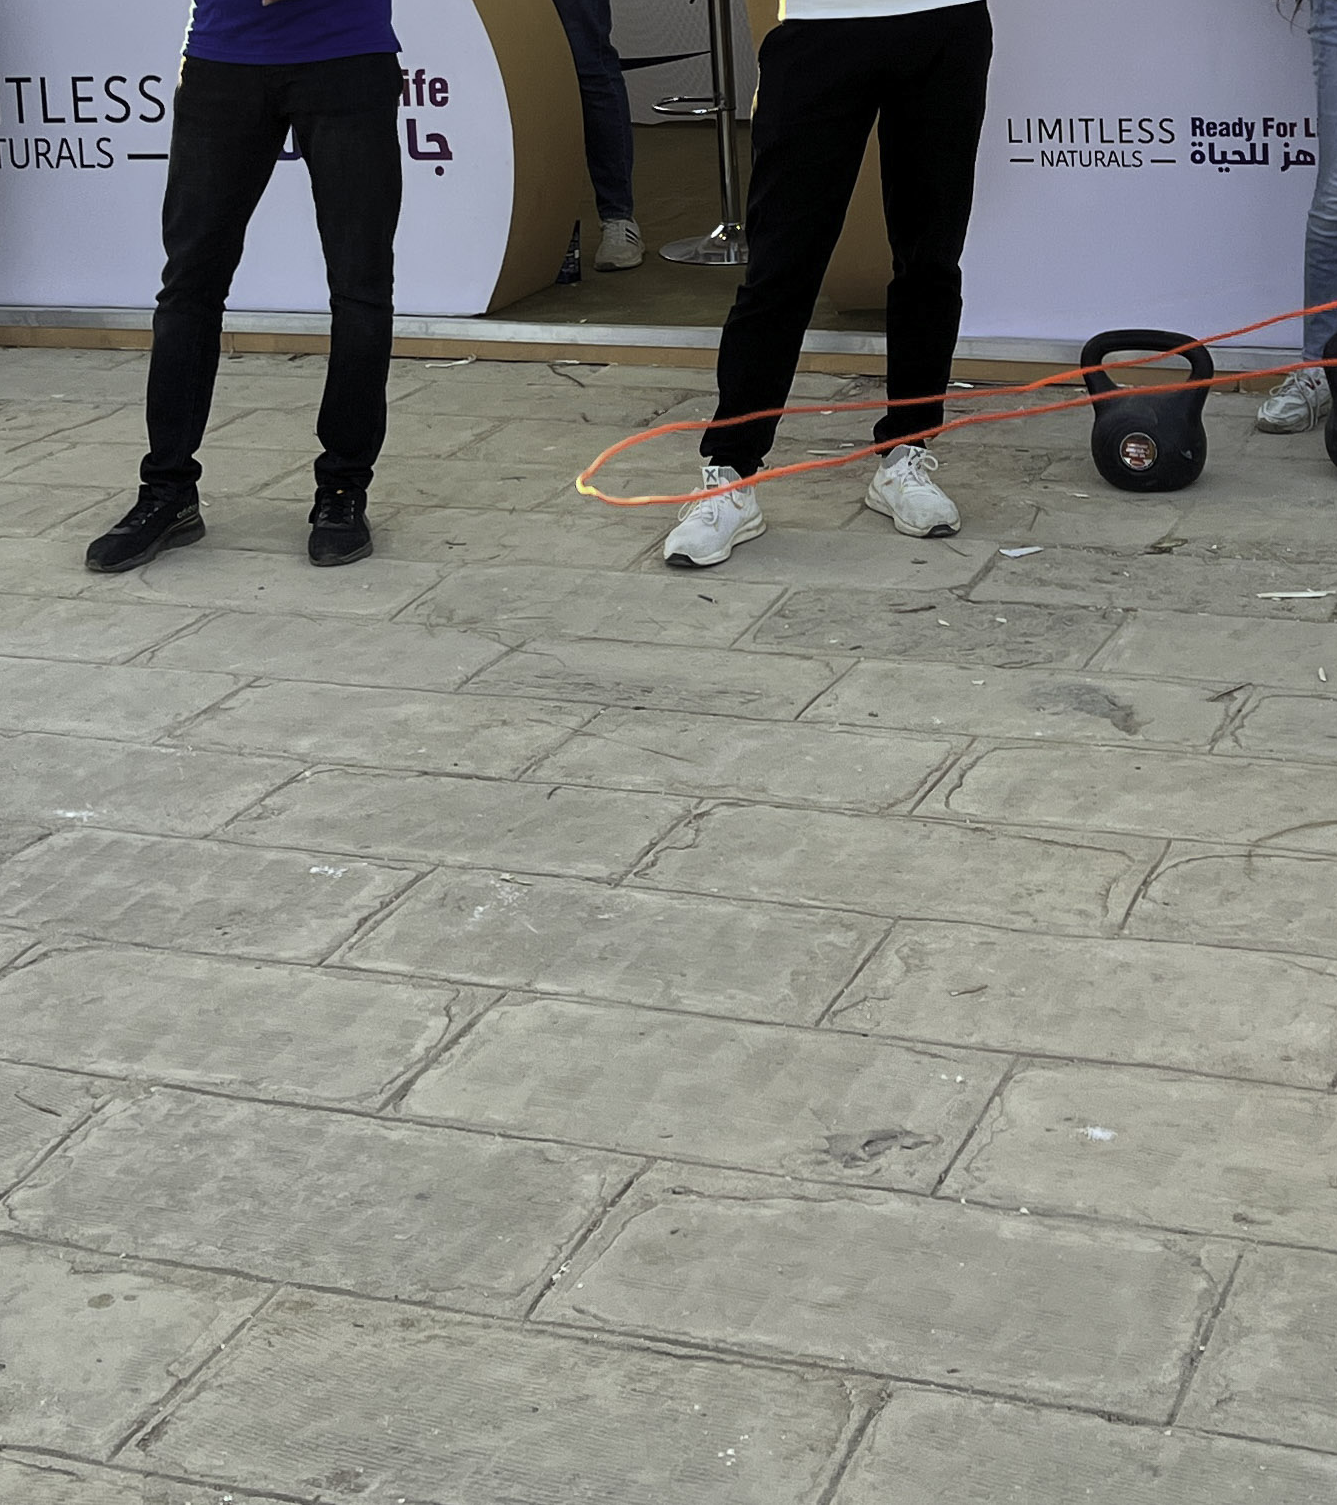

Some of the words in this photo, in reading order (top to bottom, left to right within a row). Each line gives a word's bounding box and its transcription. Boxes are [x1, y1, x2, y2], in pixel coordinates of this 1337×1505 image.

[402, 69, 450, 108] ife
[1007, 117, 1175, 145] LIMITLESS
[1190, 117, 1256, 142] Ready
[1263, 117, 1298, 138] For
[407, 118, 454, 177] جا
[1041, 150, 1143, 168] NATURALS
[1190, 142, 1270, 173] للحياة
